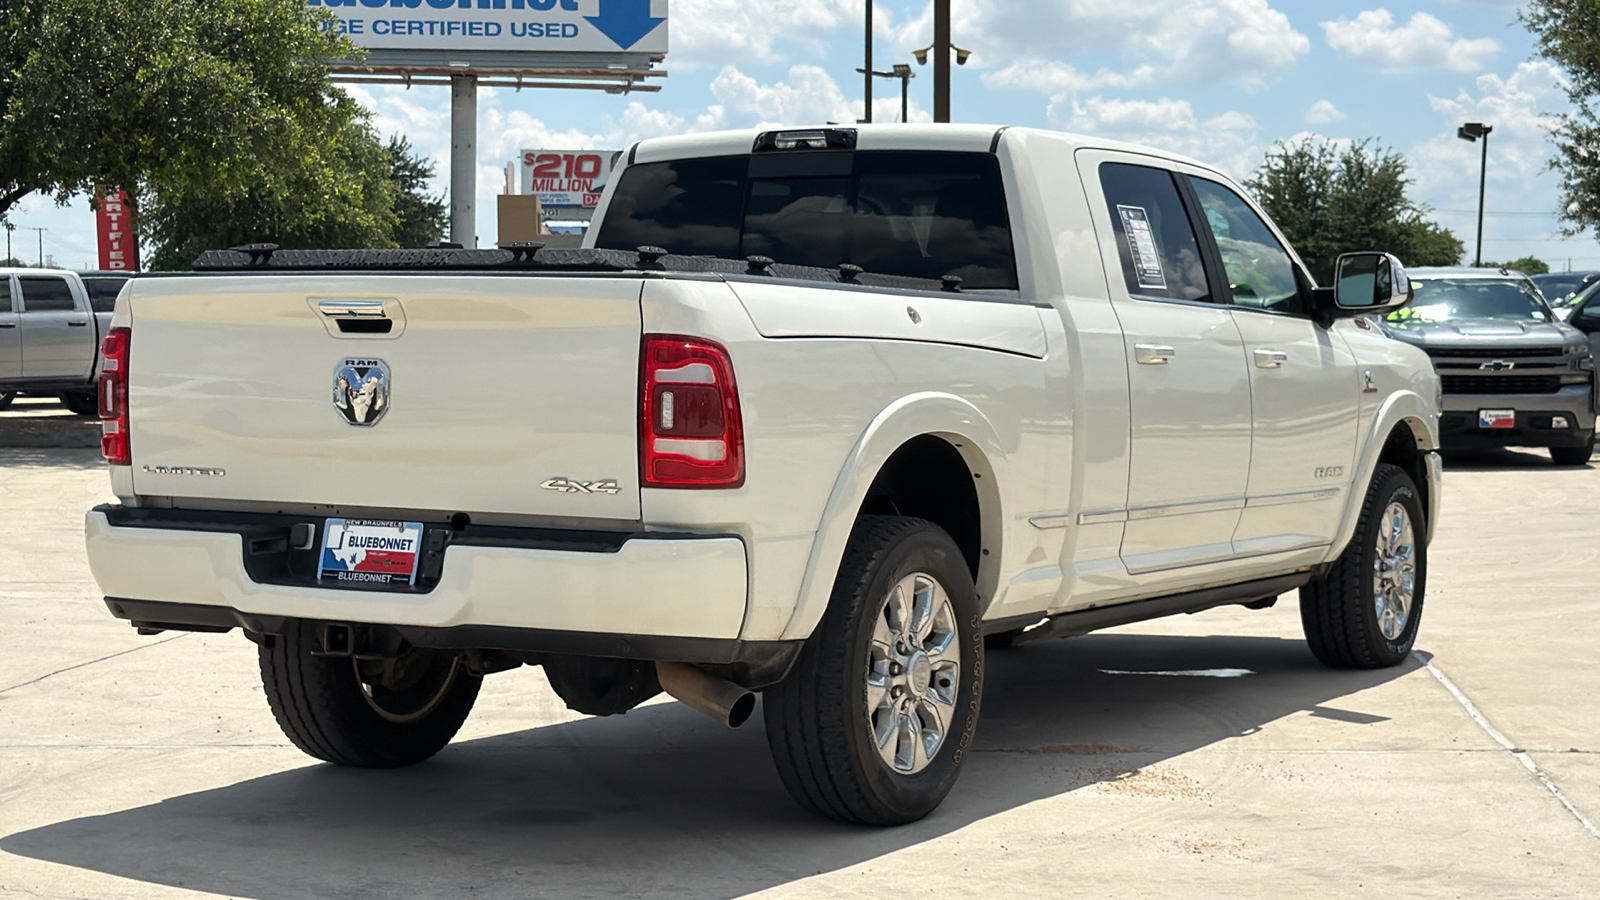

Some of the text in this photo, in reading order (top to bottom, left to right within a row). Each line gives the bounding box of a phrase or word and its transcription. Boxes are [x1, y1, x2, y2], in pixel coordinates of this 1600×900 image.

[372, 20, 502, 37] CERTIFIED
[510, 22, 579, 38] USED
[524, 152, 602, 179] $210
[532, 179, 593, 192] MILLION
[105, 184, 126, 269] ERTIFIED
[142, 465, 226, 477] LIMITED
[362, 520, 403, 528] BRAUNFELS
[348, 535, 413, 551] BLUEBONNET
[338, 571, 392, 583] BLUEBONNET
